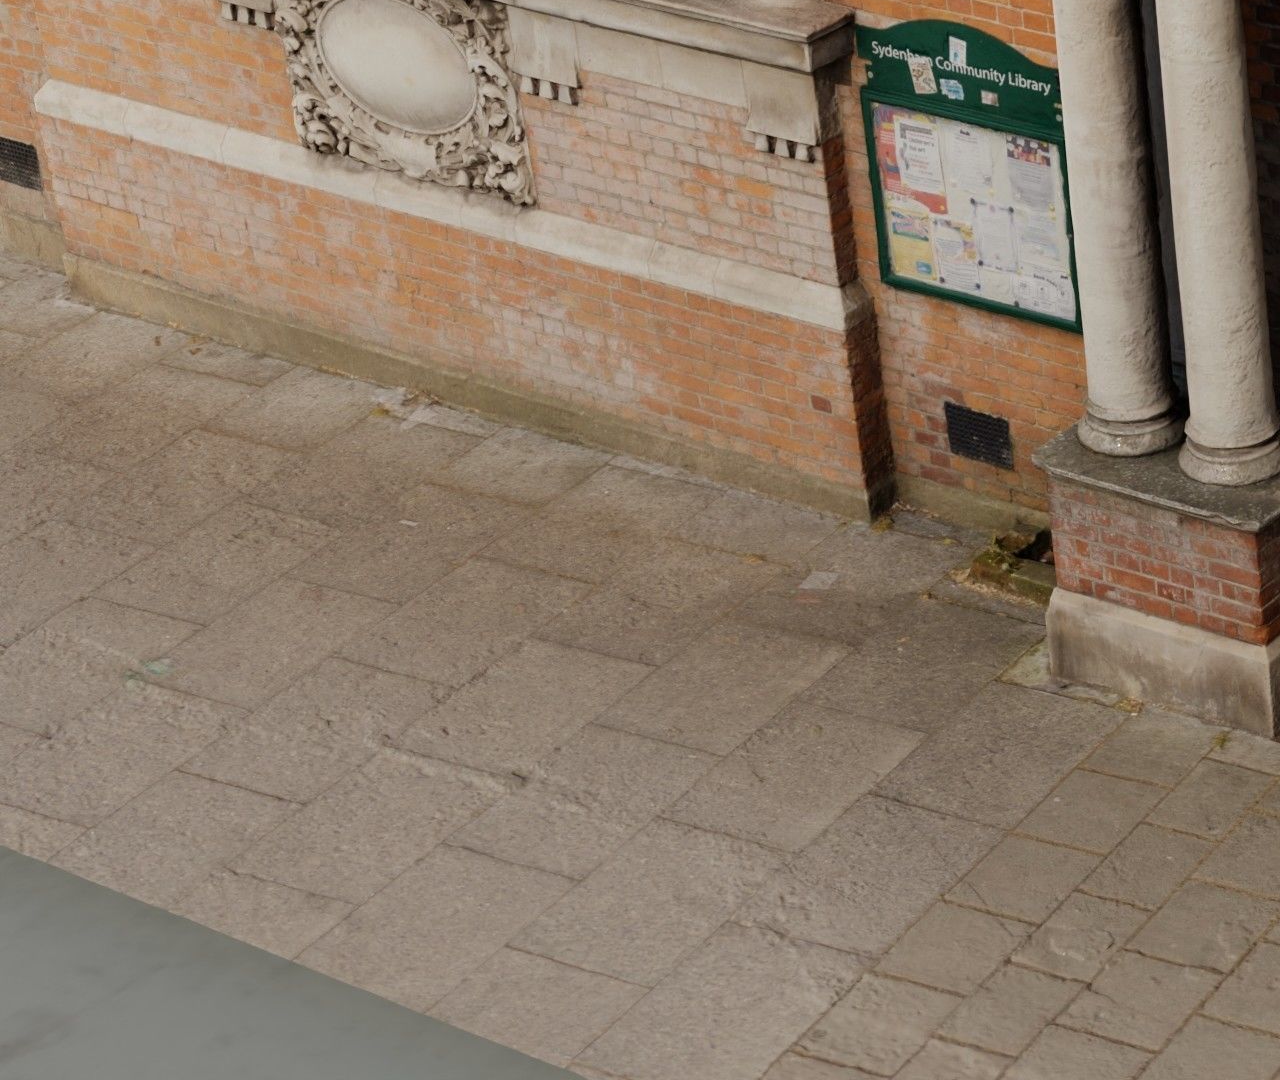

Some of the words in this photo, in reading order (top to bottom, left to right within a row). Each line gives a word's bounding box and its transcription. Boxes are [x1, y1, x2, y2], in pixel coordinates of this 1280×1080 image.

[871, 40, 933, 67] Sydenham
[935, 55, 1007, 88] Community
[1007, 71, 1052, 97] Library
